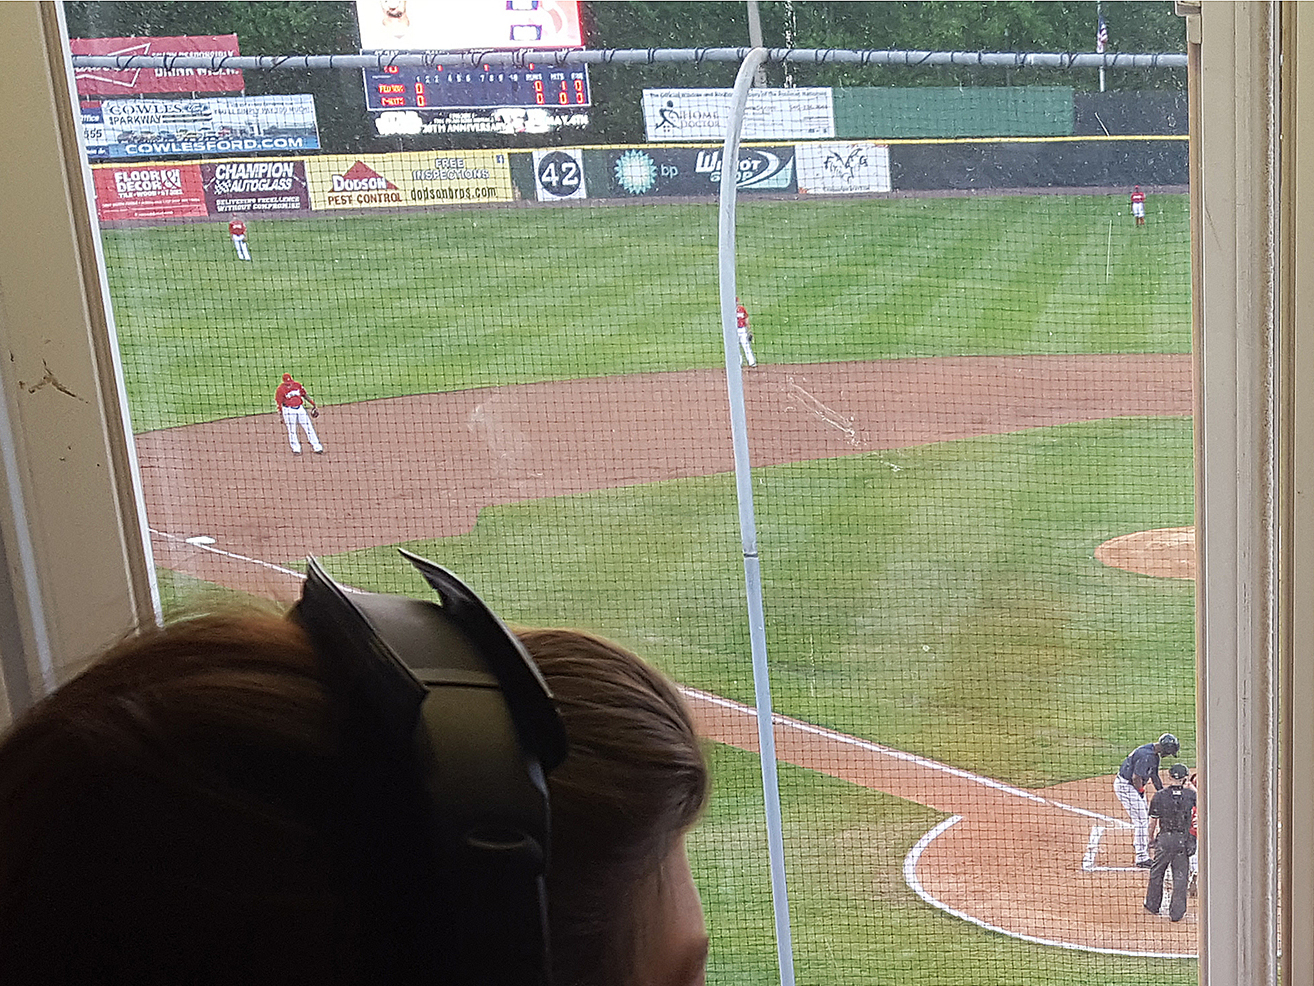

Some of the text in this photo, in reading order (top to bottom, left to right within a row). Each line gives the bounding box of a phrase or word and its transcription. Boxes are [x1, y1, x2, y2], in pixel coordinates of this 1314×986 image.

[534, 80, 544, 92] 0
[574, 80, 583, 92] 0
[536, 93, 545, 105] 0
[559, 93, 568, 105] 0
[576, 93, 585, 104] 0
[110, 103, 183, 116] COWLES
[682, 110, 719, 120] HOME
[114, 114, 162, 125] PARKWAY
[681, 120, 720, 129] DOCTOR
[126, 138, 303, 155] COWLESFORD.COM
[435, 158, 465, 169] FREE
[114, 170, 161, 183] FLOOR
[215, 162, 294, 180] CHAMPION
[412, 169, 490, 181] INSPECTIONS
[541, 162, 579, 186] 42
[661, 163, 679, 179] bp
[116, 180, 162, 193] DECOR
[229, 178, 293, 193] AUTOGLASS
[328, 192, 402, 206] PEST CONTROL
[410, 186, 498, 201] dodsonbros.com
[217, 202, 301, 213] WITHOUT COMPROMISE
